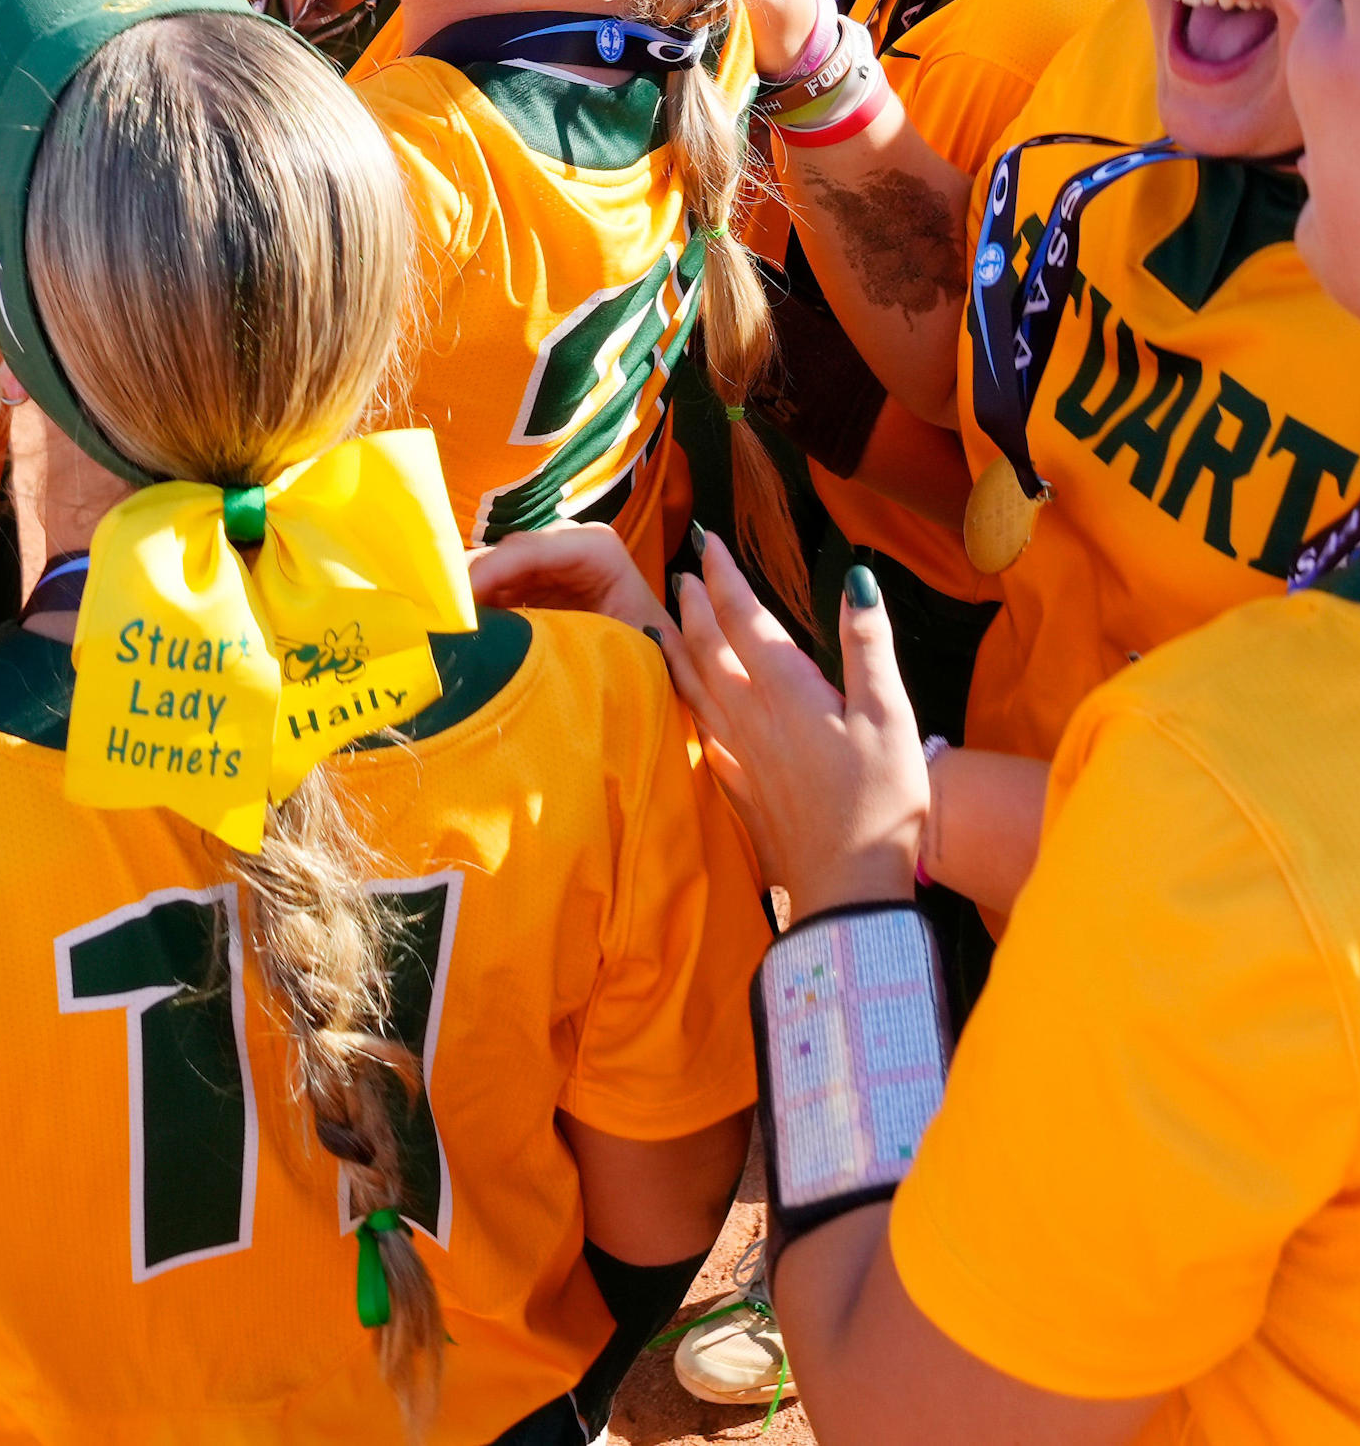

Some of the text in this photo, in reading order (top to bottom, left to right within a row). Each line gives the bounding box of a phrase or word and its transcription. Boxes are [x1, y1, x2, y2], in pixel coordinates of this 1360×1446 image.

[115, 619, 250, 675] Stuart
[129, 680, 227, 734] Lady
[287, 687, 408, 741] Haily
[106, 726, 241, 779] Hornets
